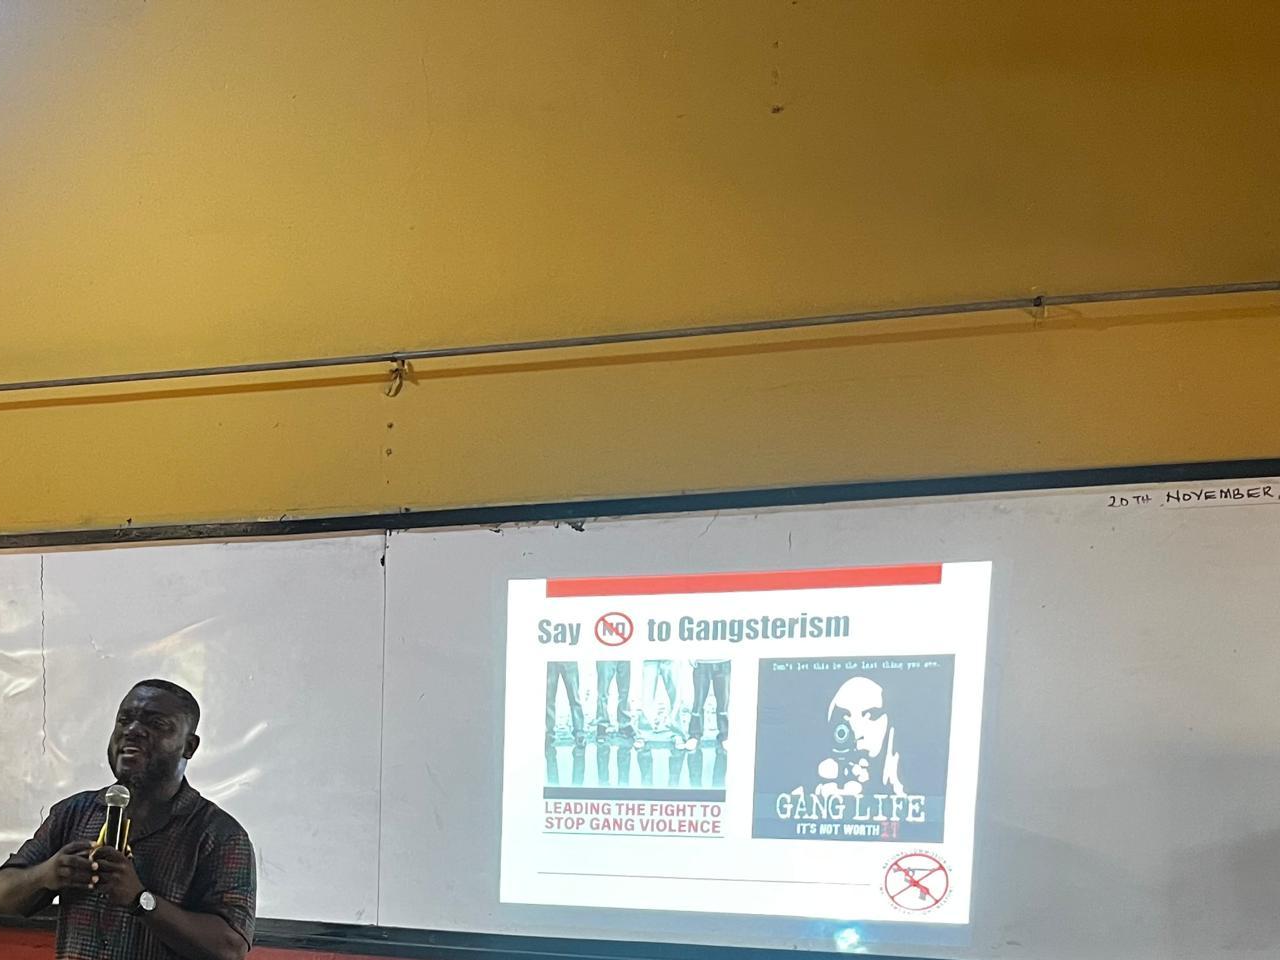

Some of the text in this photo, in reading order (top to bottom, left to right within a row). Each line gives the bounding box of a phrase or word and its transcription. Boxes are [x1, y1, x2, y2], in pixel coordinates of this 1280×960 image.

[538, 619, 581, 646] Say
[647, 619, 671, 642] to
[678, 613, 850, 643] Gangsterism
[544, 801, 722, 817] LEADING THE FIGHT TO
[776, 792, 925, 822] GANG LIFE
[544, 816, 721, 833] STOP GANG VIOLENCE
[796, 821, 899, 838] IT'S NOT WORTH IT
